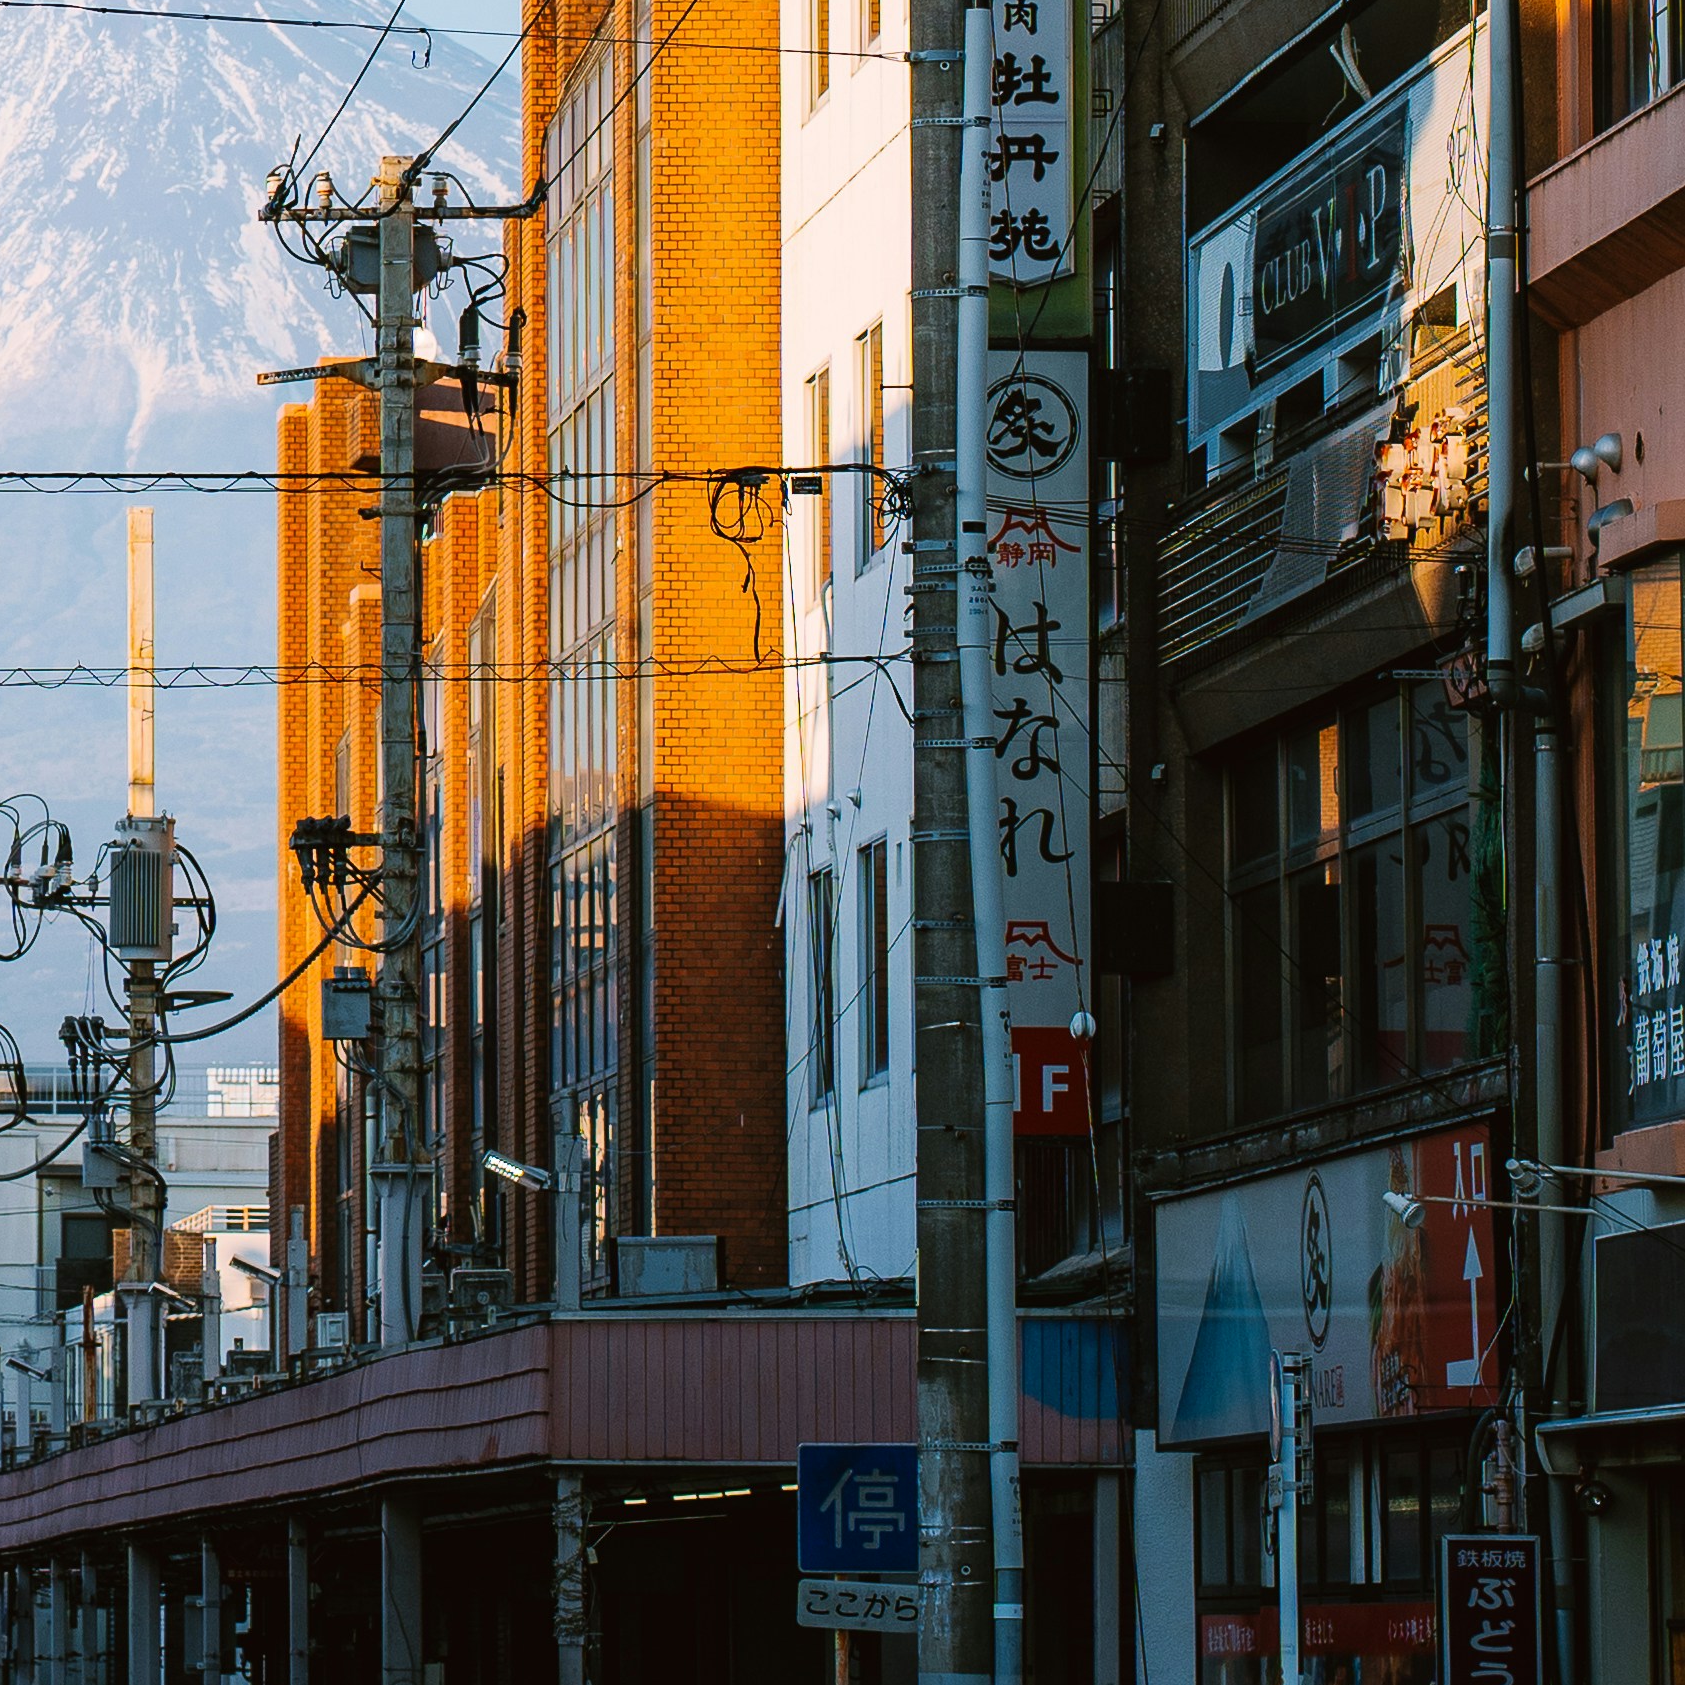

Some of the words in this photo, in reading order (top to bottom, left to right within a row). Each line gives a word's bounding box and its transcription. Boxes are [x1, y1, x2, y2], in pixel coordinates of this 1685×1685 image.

[989, 51, 1060, 260] 牡丹苑
[1261, 238, 1312, 316] CLUB
[995, 541, 1057, 569] 静岡
[993, 600, 1076, 878] はなれ
[1006, 953, 1059, 982] 富士
[1453, 1141, 1488, 1221] 入口
[819, 1468, 906, 1550] 停
[1456, 1548, 1526, 1569] 鉄板焼
[805, 1590, 919, 1622] ここから
